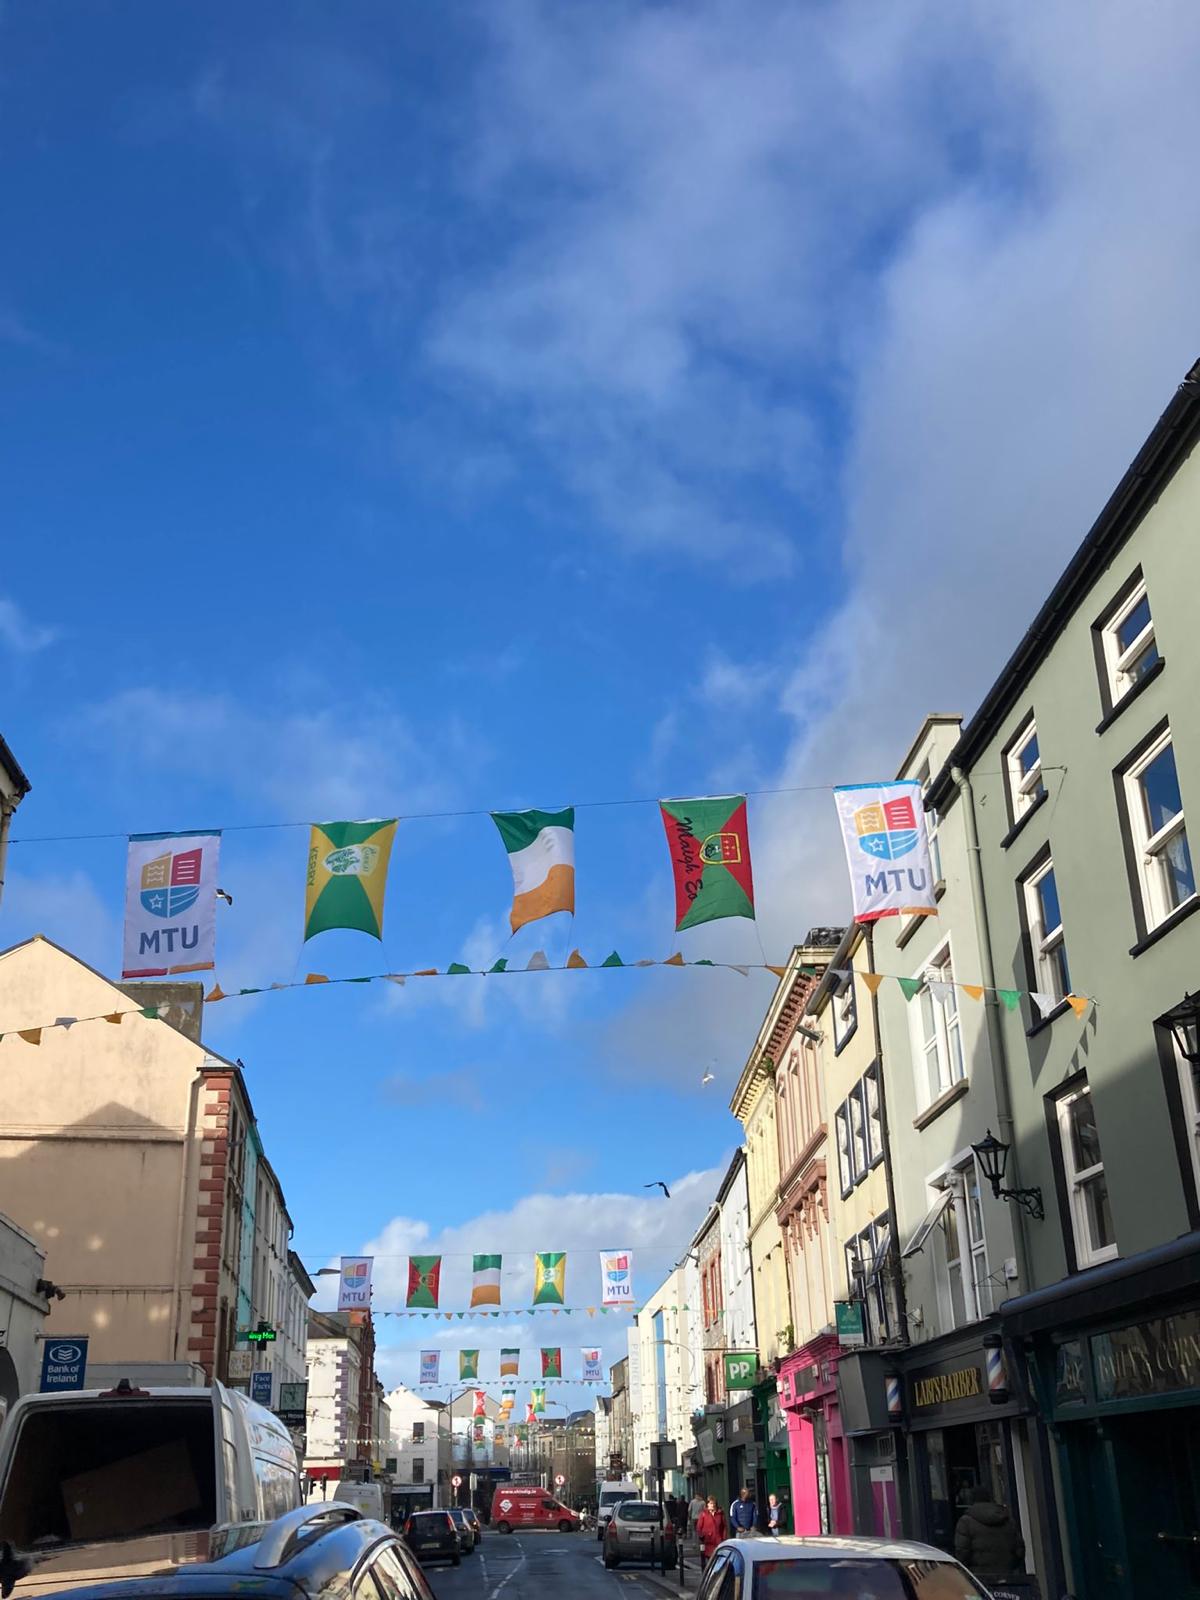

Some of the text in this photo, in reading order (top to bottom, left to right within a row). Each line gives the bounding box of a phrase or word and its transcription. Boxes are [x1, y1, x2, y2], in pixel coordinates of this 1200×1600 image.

[307, 846, 319, 888] KERRY
[685, 879, 704, 901] Eo
[865, 868, 926, 896] MTU
[139, 925, 199, 954] MTU
[342, 1292, 366, 1302] MTU
[607, 1285, 630, 1295] MTU
[46, 1375, 78, 1383] Ireland
[47, 1365, 80, 1373] Bank of
[940, 1368, 979, 1402] BARBER
